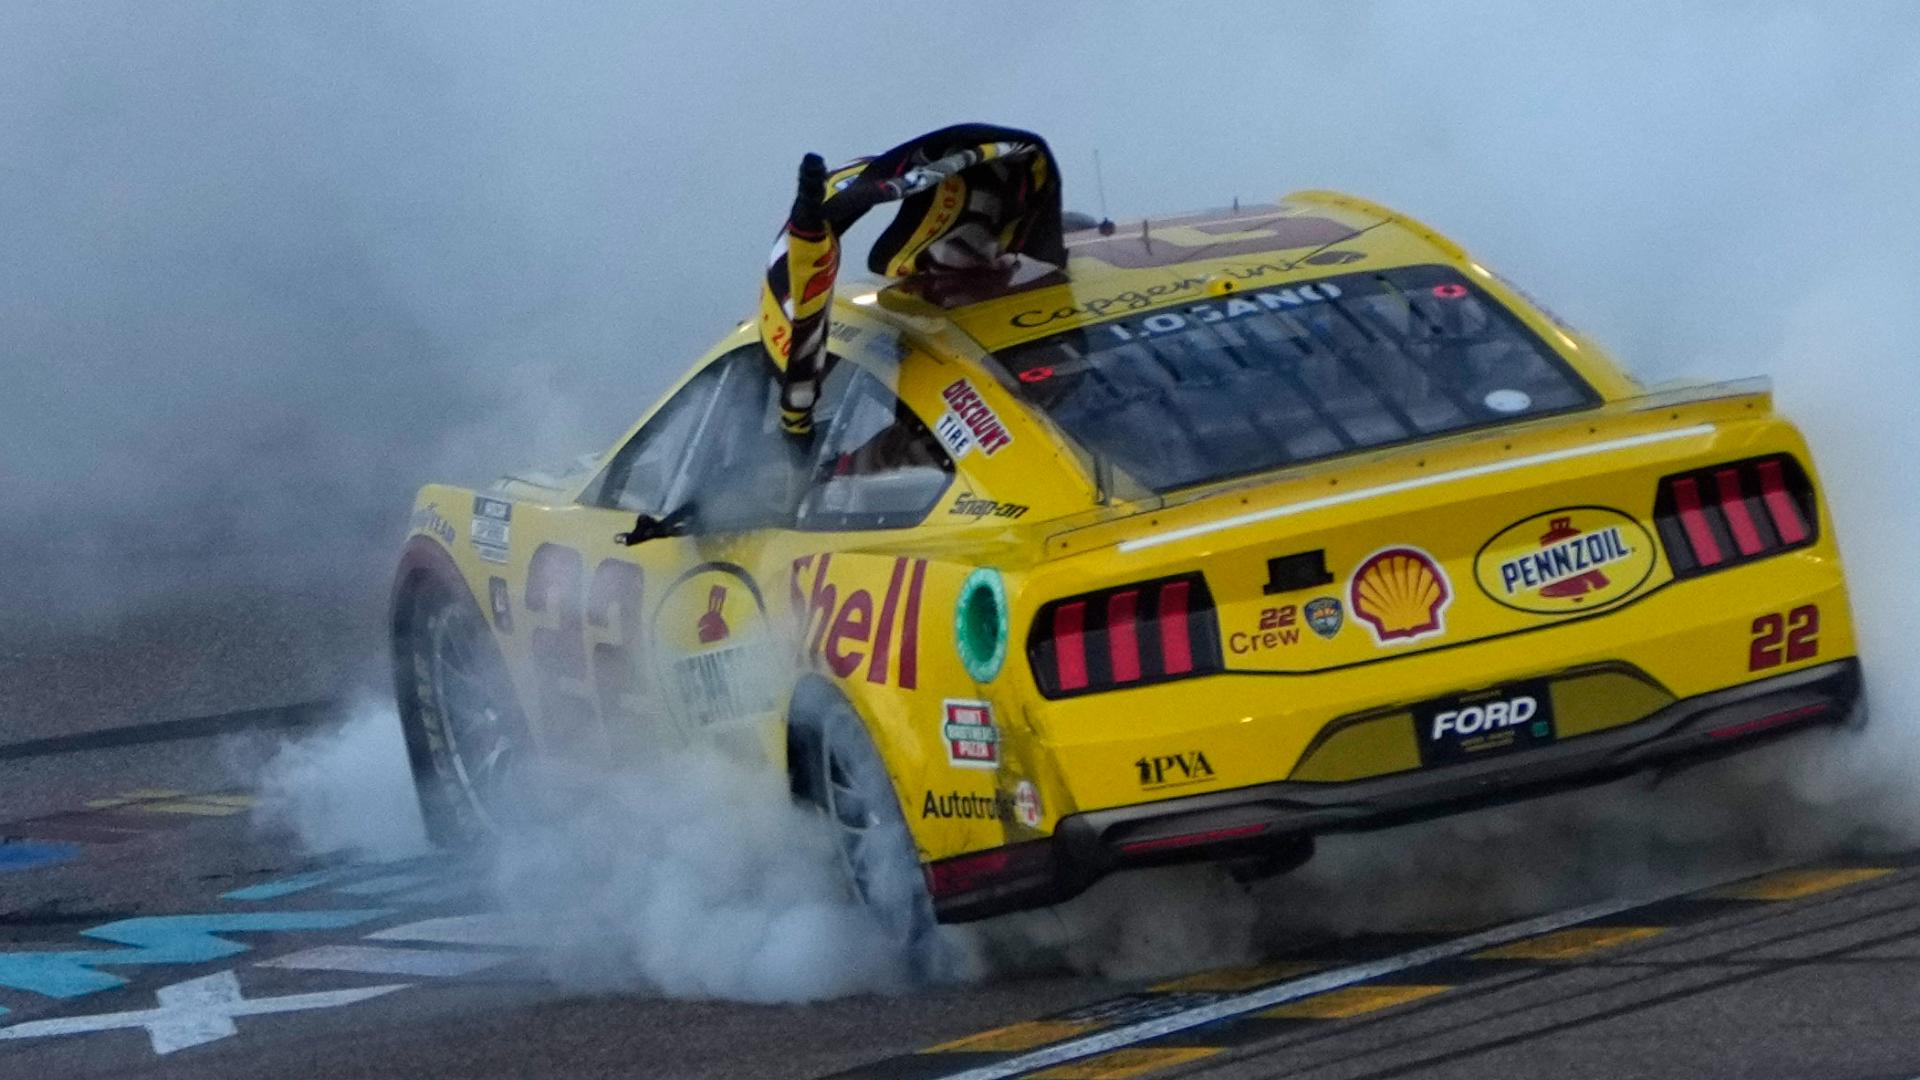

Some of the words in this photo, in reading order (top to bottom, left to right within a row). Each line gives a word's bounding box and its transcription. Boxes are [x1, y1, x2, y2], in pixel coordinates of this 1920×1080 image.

[939, 416, 971, 453] TIRE
[942, 378, 1012, 456] DISCOUNT
[949, 492, 1029, 524] Snap-on
[1501, 527, 1630, 594] PENNZOIL
[790, 552, 928, 689] Shell
[1259, 605, 1297, 631] 22
[1748, 603, 1819, 672] 22
[1229, 629, 1300, 655] Crew
[1433, 696, 1537, 740] FORD
